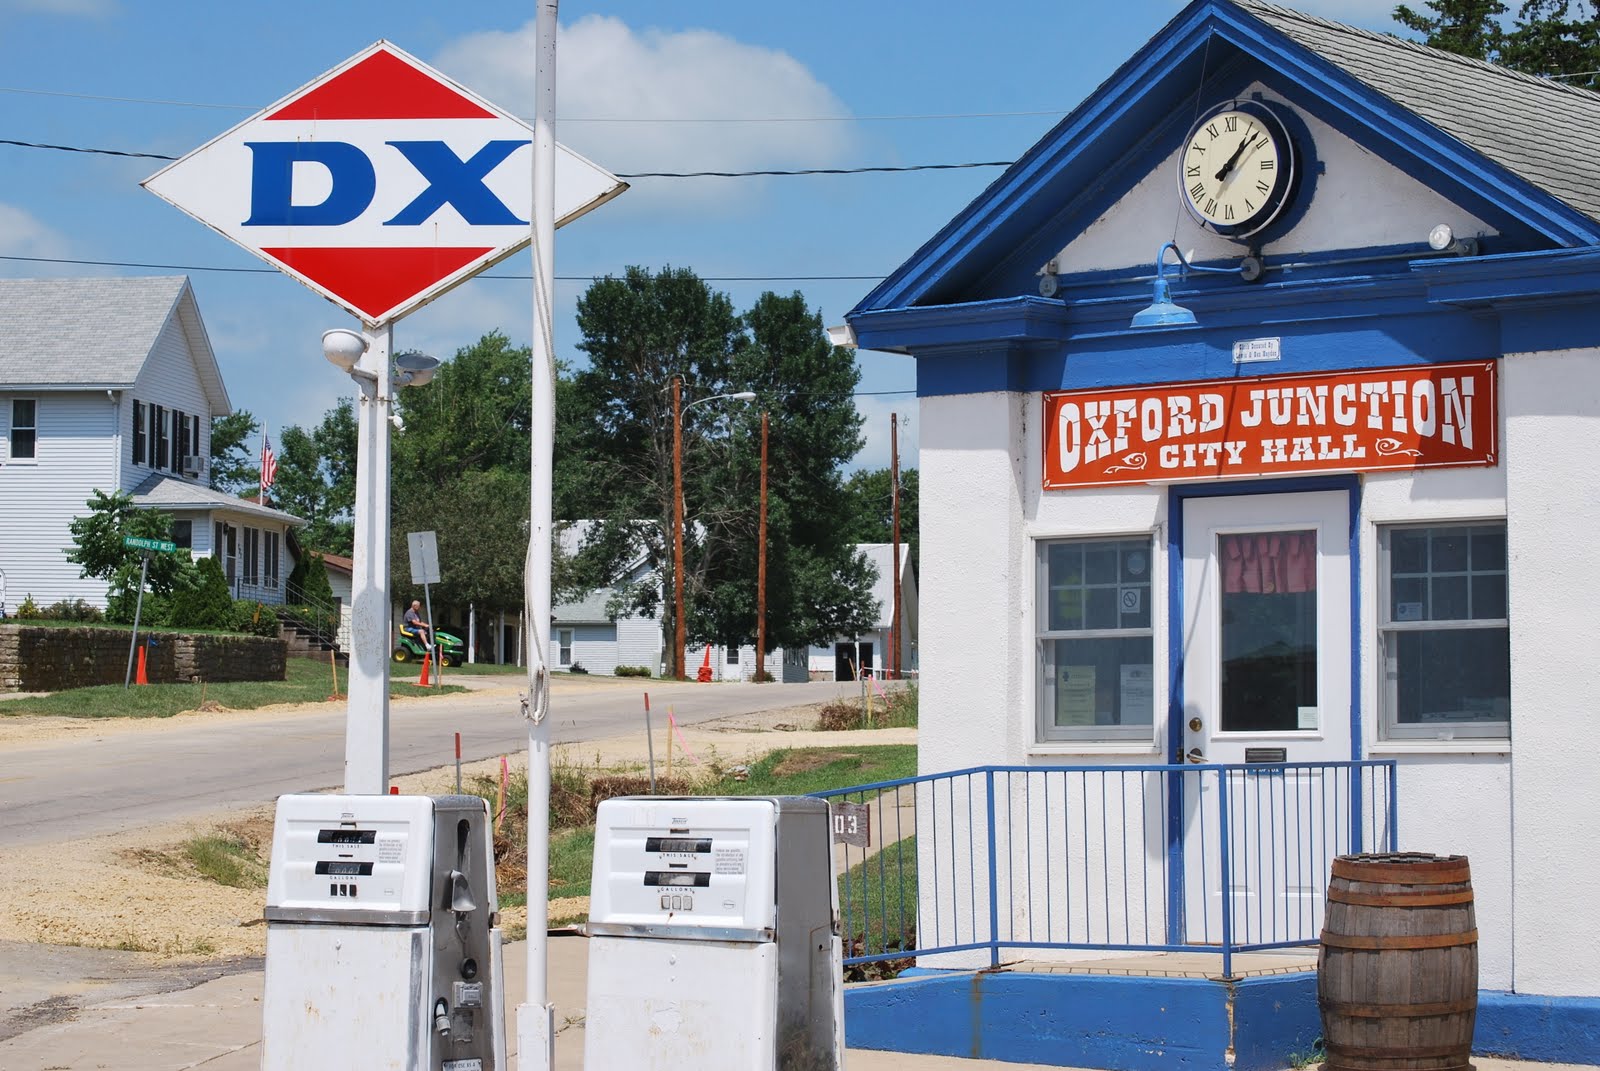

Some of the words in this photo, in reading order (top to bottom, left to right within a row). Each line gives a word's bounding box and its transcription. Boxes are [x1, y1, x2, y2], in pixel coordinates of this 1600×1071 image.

[1224, 116, 1237, 132] XII
[1245, 122, 1254, 136] I
[1206, 124, 1220, 141] XI
[1193, 142, 1206, 156] X
[1256, 137, 1269, 150] II
[1188, 165, 1200, 177] IX
[1260, 160, 1274, 170] III
[241, 140, 533, 226] DX
[1256, 180, 1269, 196] IV
[1190, 182, 1206, 204] VIII
[1204, 198, 1218, 217] VII
[1224, 204, 1235, 220] VI
[1244, 198, 1254, 213] V
[1058, 394, 1224, 473] OXFORD
[1240, 376, 1474, 451] JUNCTION
[1160, 440, 1247, 468] CITY
[1261, 434, 1366, 463] HALL
[126, 538, 150, 548] RANDOLPH
[161, 542, 173, 551] WEST
[835, 815, 857, 834] 03
